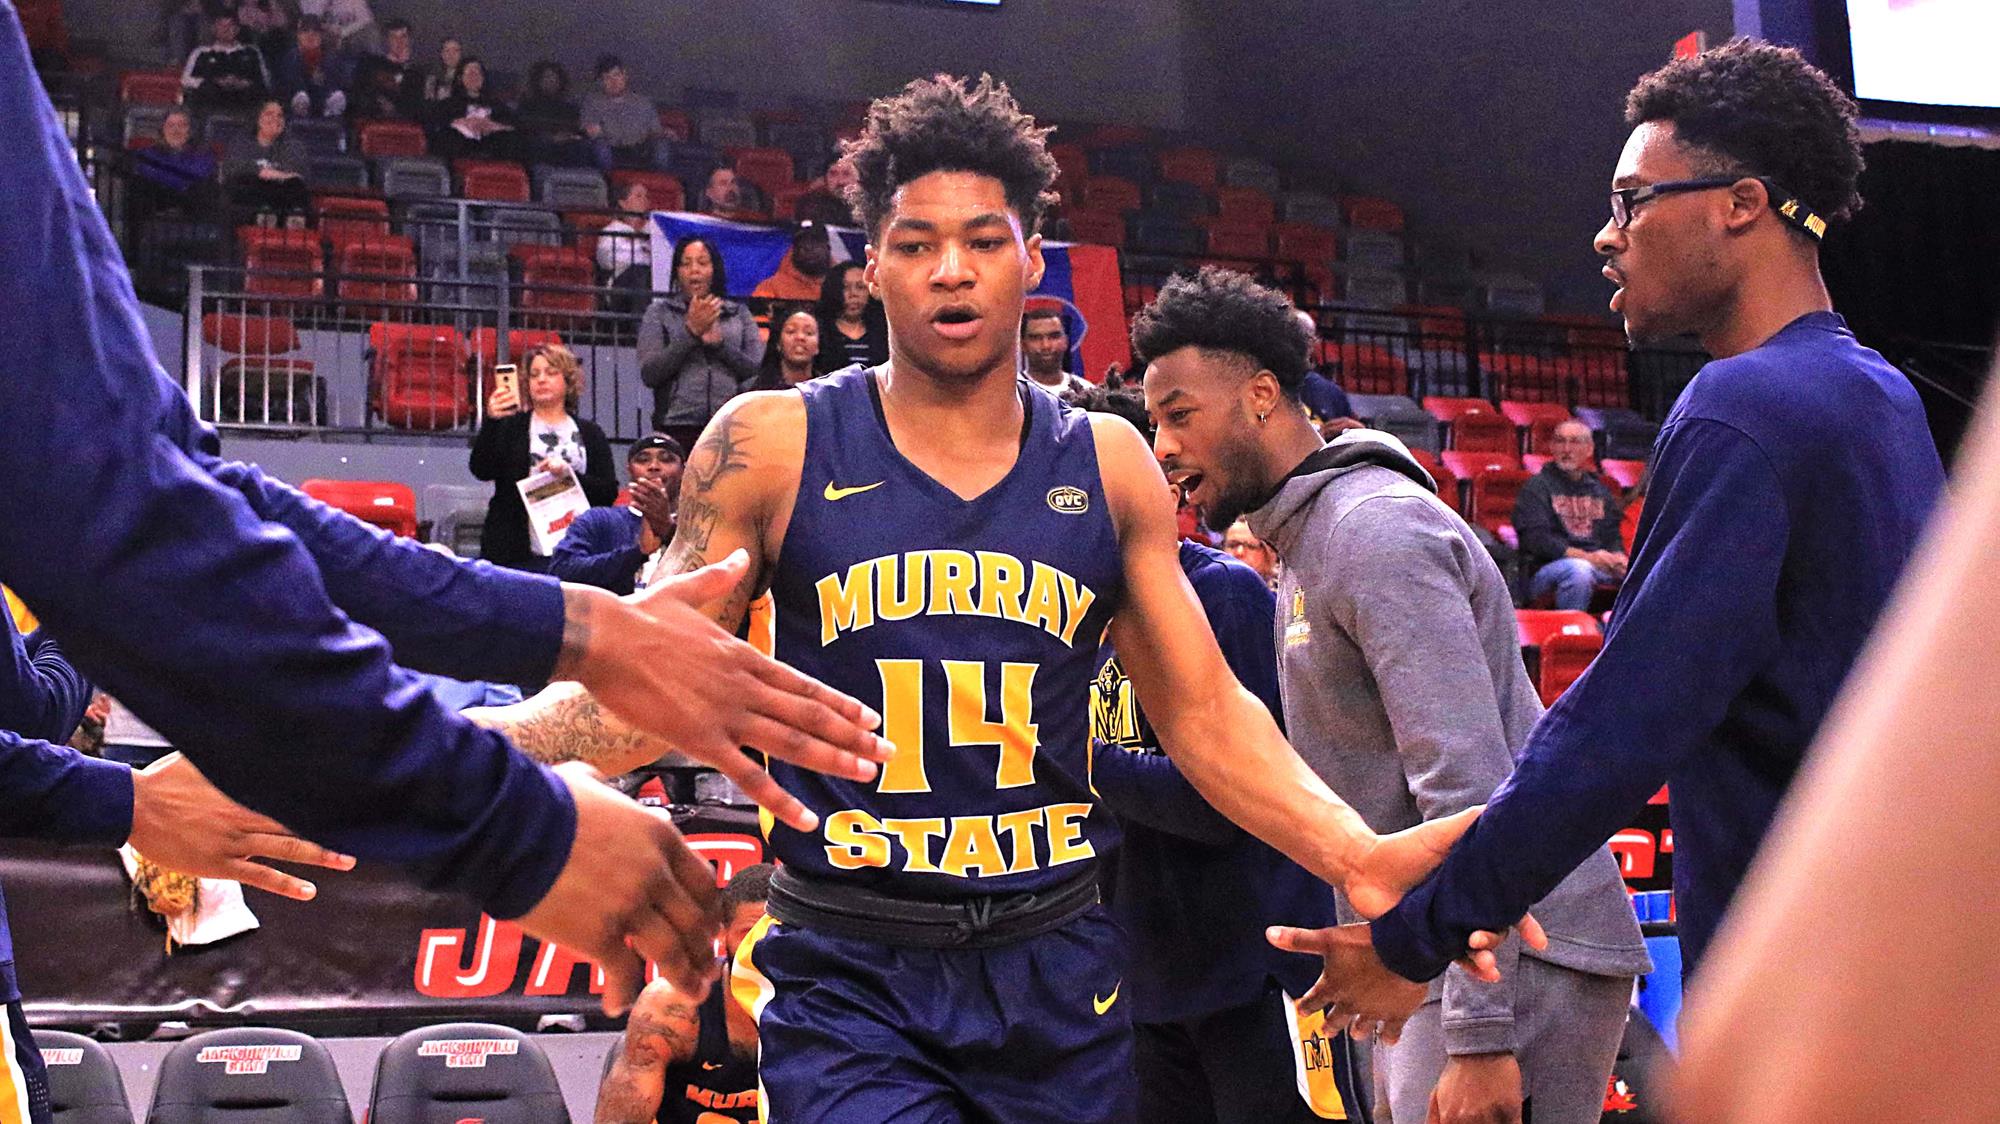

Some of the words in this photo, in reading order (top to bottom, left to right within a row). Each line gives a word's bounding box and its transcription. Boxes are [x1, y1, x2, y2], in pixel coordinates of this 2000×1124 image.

[815, 549, 1096, 648] MURRAY
[875, 658, 1041, 793] 14
[823, 802, 1096, 878] STATE
